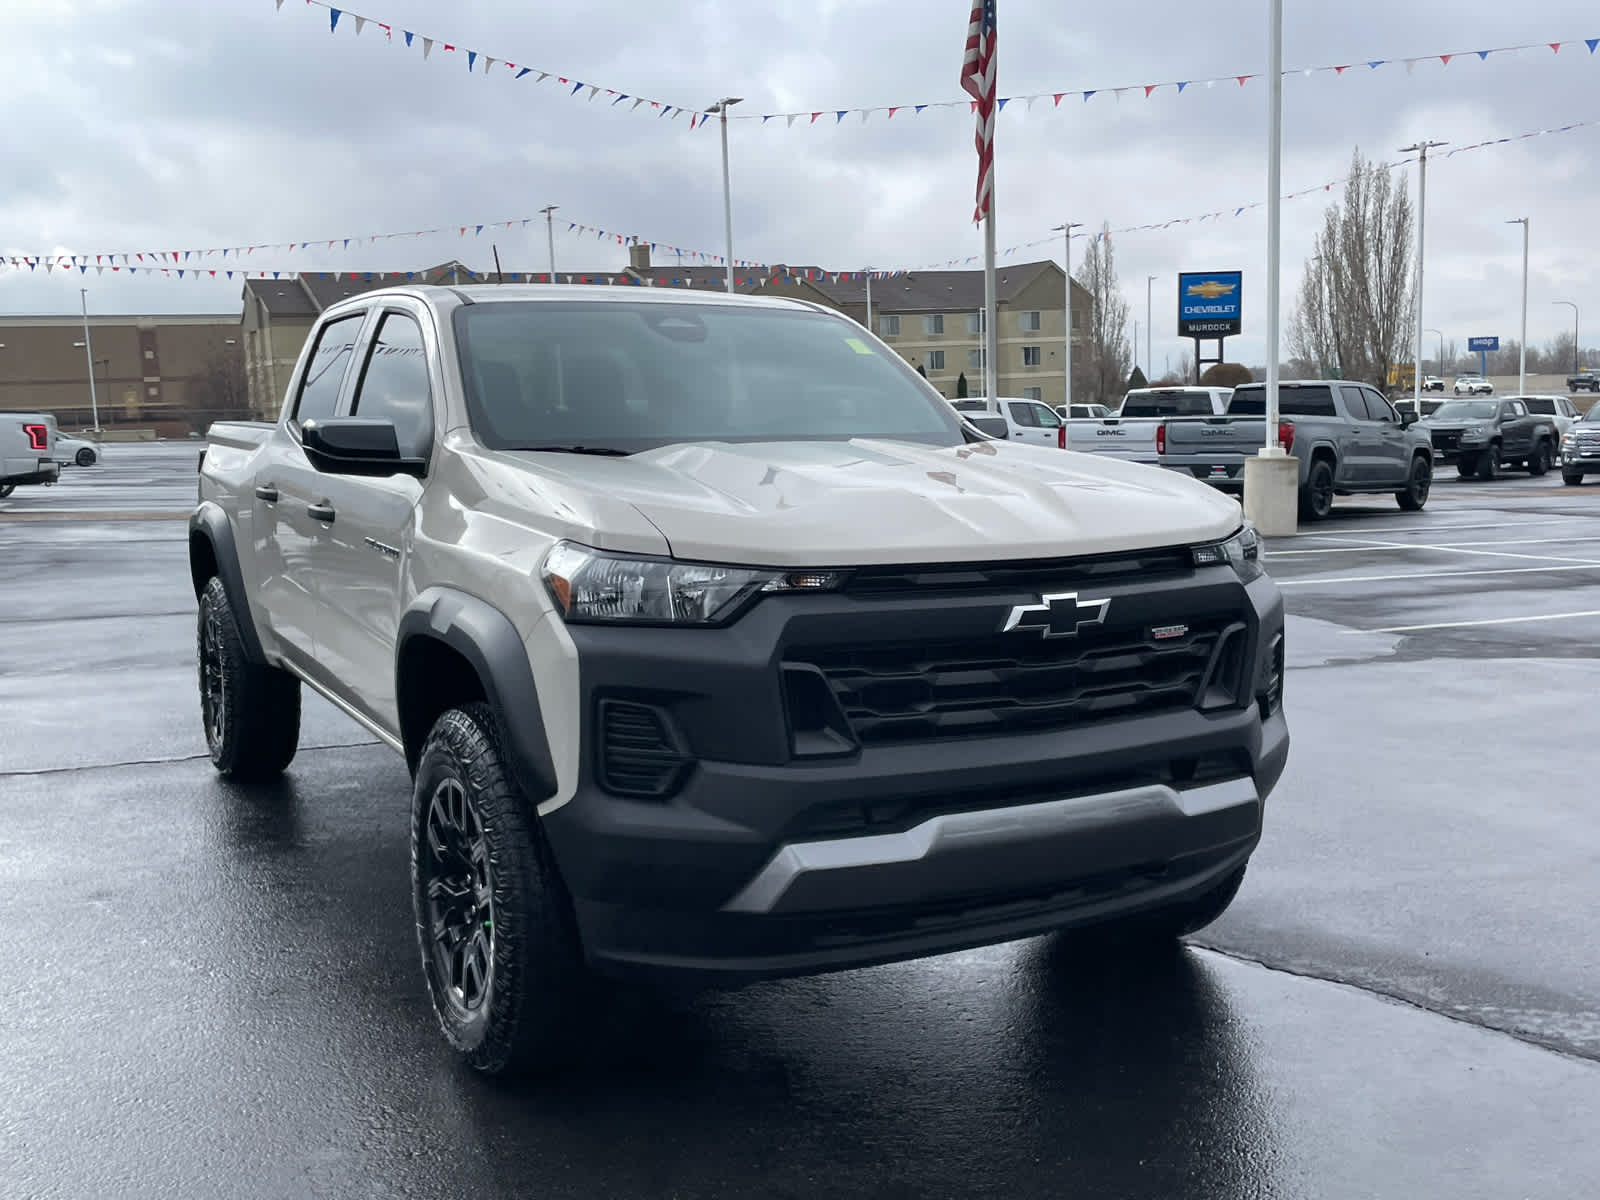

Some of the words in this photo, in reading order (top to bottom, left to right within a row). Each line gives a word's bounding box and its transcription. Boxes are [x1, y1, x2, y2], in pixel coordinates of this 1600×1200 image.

[1184, 305, 1235, 314] CHEVROLET
[1188, 323, 1230, 331] MURDOCK
[1200, 429, 1235, 437] GMC
